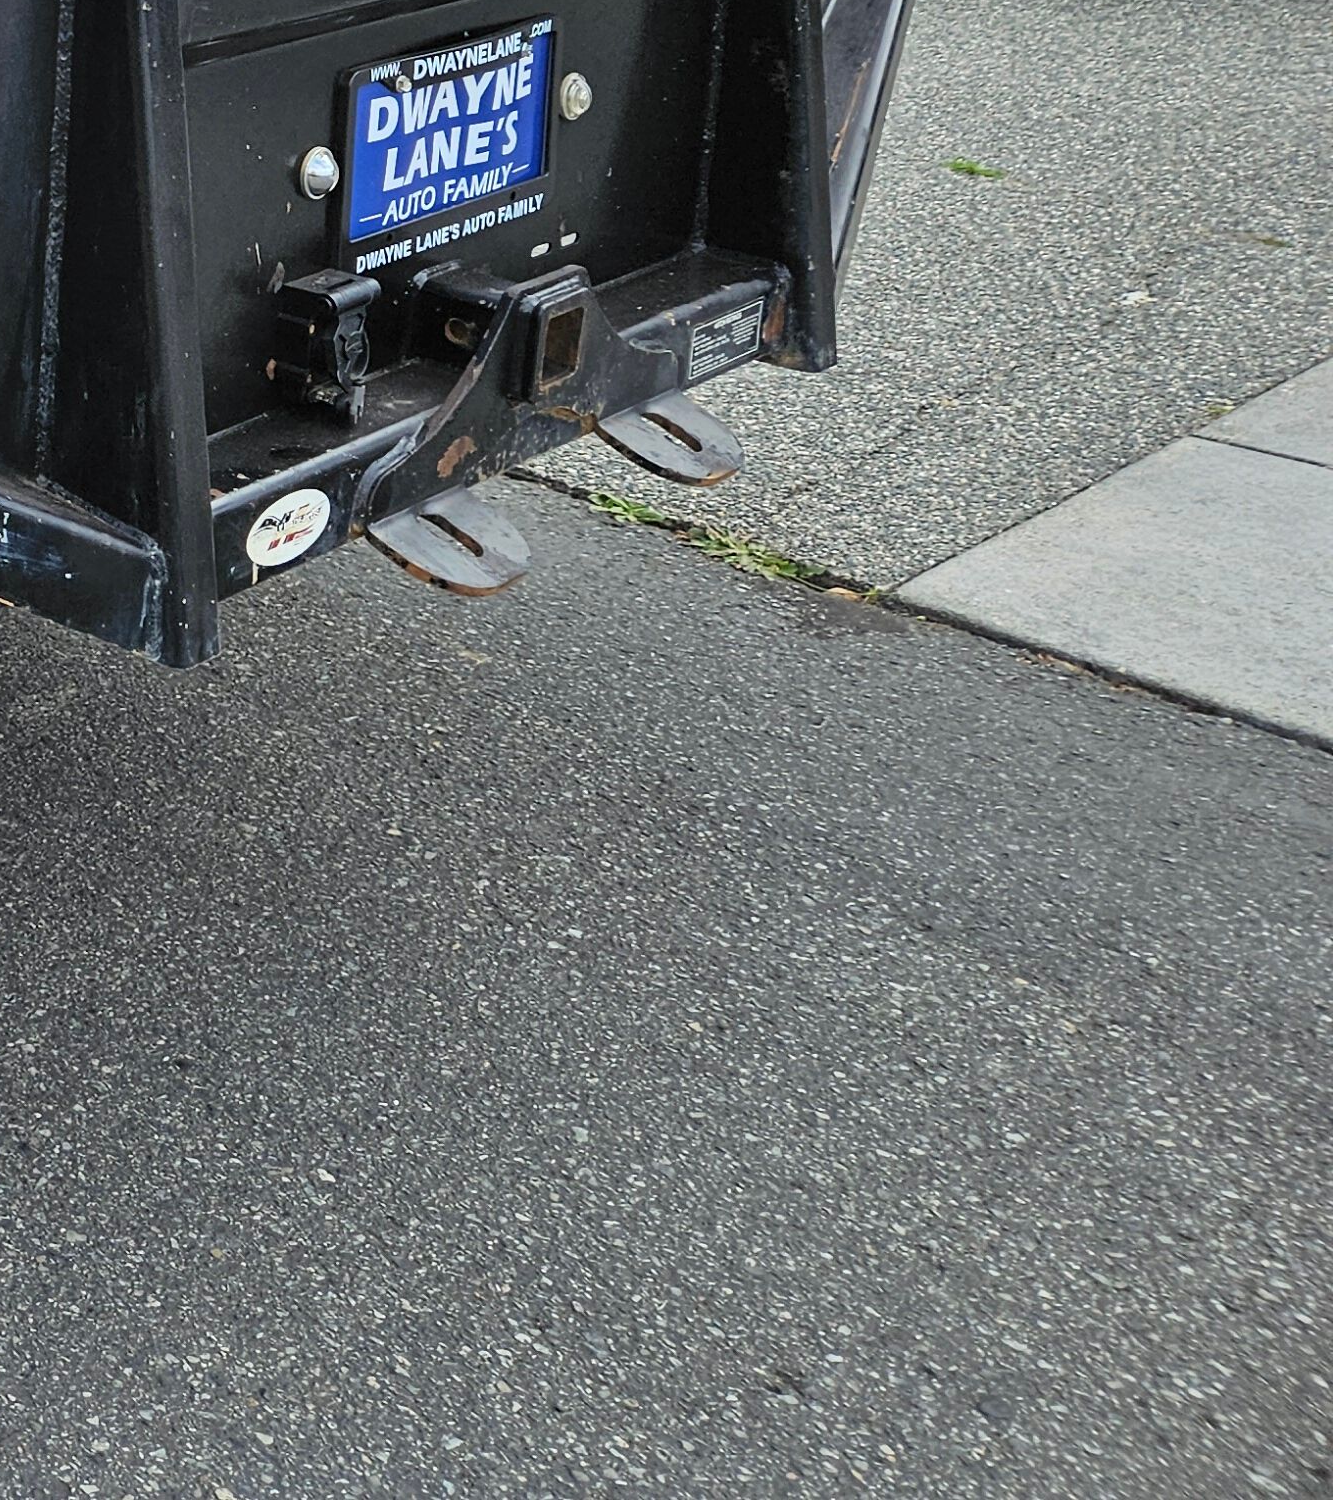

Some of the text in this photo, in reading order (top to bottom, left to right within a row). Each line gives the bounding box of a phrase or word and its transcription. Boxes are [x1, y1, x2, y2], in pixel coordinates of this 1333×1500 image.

[366, 55, 534, 143] DWAYNE
[383, 110, 519, 192] LANE'S
[355, 193, 545, 275] DWAYNE LANE'S AUTO FAMILY
[381, 163, 514, 226] AUTO FAMILY
